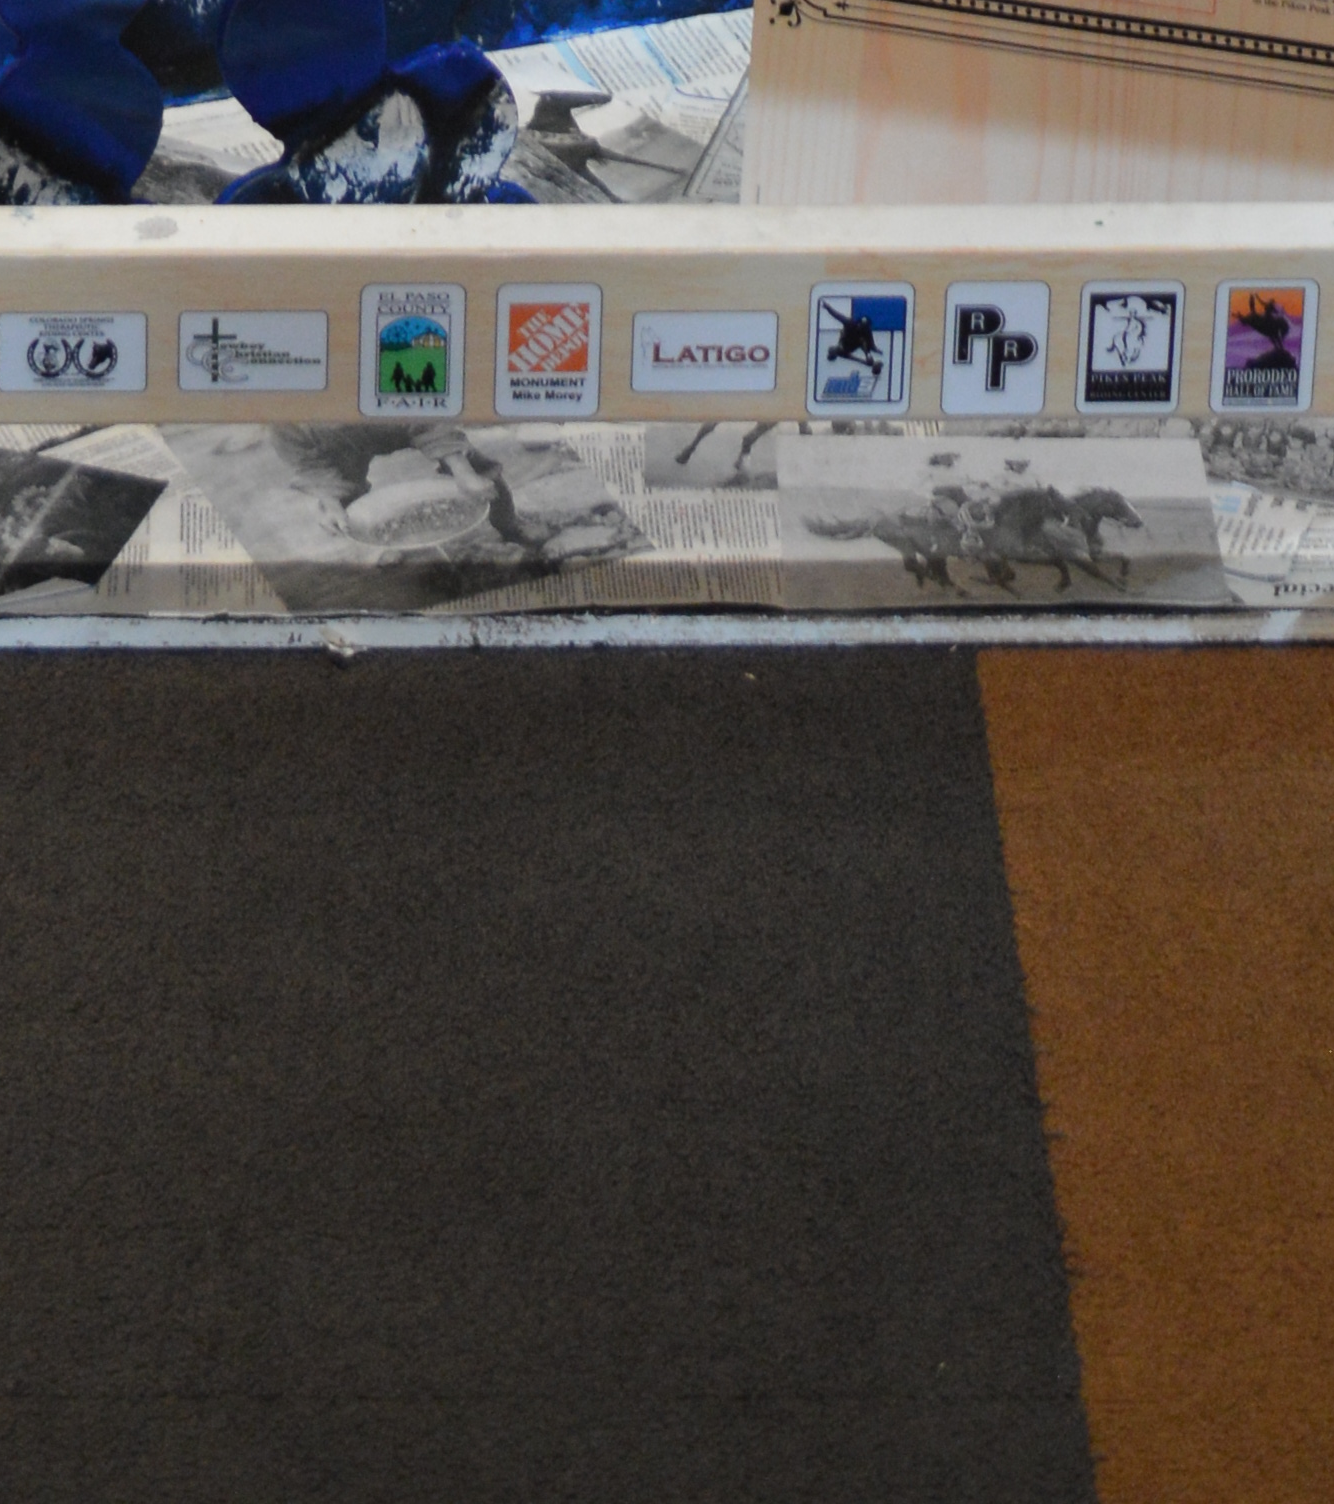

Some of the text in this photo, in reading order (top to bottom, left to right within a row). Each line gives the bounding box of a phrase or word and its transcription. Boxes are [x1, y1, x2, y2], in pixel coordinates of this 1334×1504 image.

[379, 292, 450, 301] EL PASO
[377, 304, 450, 314] COUNTY
[652, 342, 771, 364] LATIGO
[1227, 368, 1297, 384] PRORODEO
[510, 377, 585, 388] MONUMENT
[512, 390, 582, 402] Mike Morey
[1225, 384, 1252, 397] HALL
[1253, 385, 1265, 397] OF
